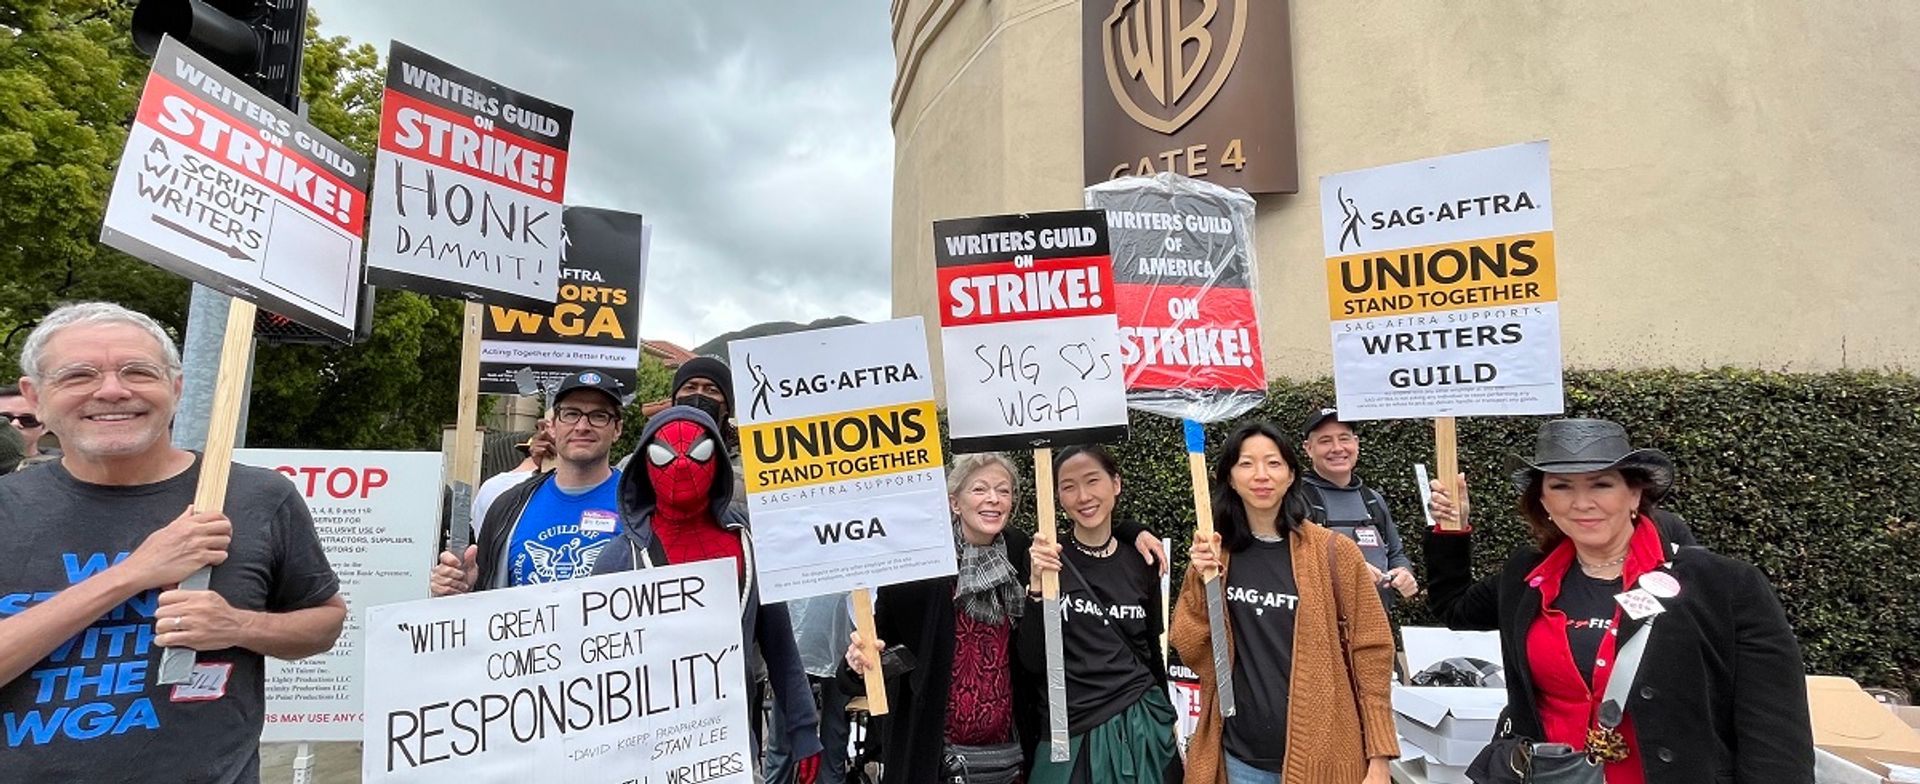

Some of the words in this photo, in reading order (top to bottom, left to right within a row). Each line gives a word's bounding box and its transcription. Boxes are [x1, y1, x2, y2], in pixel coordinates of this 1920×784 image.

[174, 56, 290, 138] WRITERS
[294, 131, 356, 178] GUILD
[401, 62, 499, 118] WRITERS
[502, 103, 560, 138] GUILD
[259, 128, 284, 147] ON
[473, 115, 495, 131] ON
[156, 94, 353, 224] STRIKE!
[394, 106, 555, 194] STRIKE!
[1220, 138, 1247, 171] 4
[143, 154, 265, 222] WITHOUT
[149, 137, 170, 160] A
[180, 153, 271, 205] SCRIPT
[137, 172, 260, 249] WRITERS
[394, 158, 550, 249] HONK
[1107, 209, 1182, 232] WRITERS
[1186, 214, 1234, 234] GUILD
[396, 225, 543, 286] DAMMIT!
[945, 230, 1037, 257] WRITERS
[1038, 226, 1097, 250] GUILD
[1164, 237, 1183, 252] OF
[1014, 254, 1034, 269] ON
[1138, 258, 1216, 279] AMERICA
[1340, 239, 1539, 294] UNIONS
[560, 284, 628, 306] ORTS
[949, 266, 1103, 319] STRIKE!
[1168, 297, 1201, 320] ON
[1344, 294, 1414, 315] STAND
[1417, 281, 1541, 308] TOGETHER
[488, 302, 626, 340] WGA
[1447, 307, 1543, 324] SUPPORTS
[513, 349, 551, 359] Together
[552, 349, 566, 358] for
[572, 351, 599, 360] Better
[599, 353, 627, 361] Future
[1119, 326, 1255, 368] STRIKE!
[1361, 322, 1523, 355] WRITERS
[974, 344, 1041, 385] SAG
[1388, 363, 1498, 388] GUILD
[997, 385, 1080, 428] WGA
[752, 407, 927, 464] UNIONS
[758, 461, 824, 487] STAND
[826, 447, 930, 478] TOGETHER
[760, 483, 848, 505] SAG-AFTRA
[855, 471, 934, 493] SUPPORTS
[538, 524, 580, 541] GUILD
[813, 516, 887, 546] WGA
[488, 604, 560, 642] GREAT
[582, 576, 706, 627] POWER
[1227, 586, 1299, 611] SAG·AFT
[487, 643, 561, 682] COMES
[580, 628, 647, 665] GREAT
[32, 660, 149, 704] THE
[3, 697, 160, 748] WGA
[280, 713, 306, 723] MAY
[307, 713, 330, 723] USE
[333, 713, 357, 723] ANY
[650, 734, 693, 761] STAN
[699, 725, 729, 747] LEE
[665, 751, 744, 784] WRITERS
